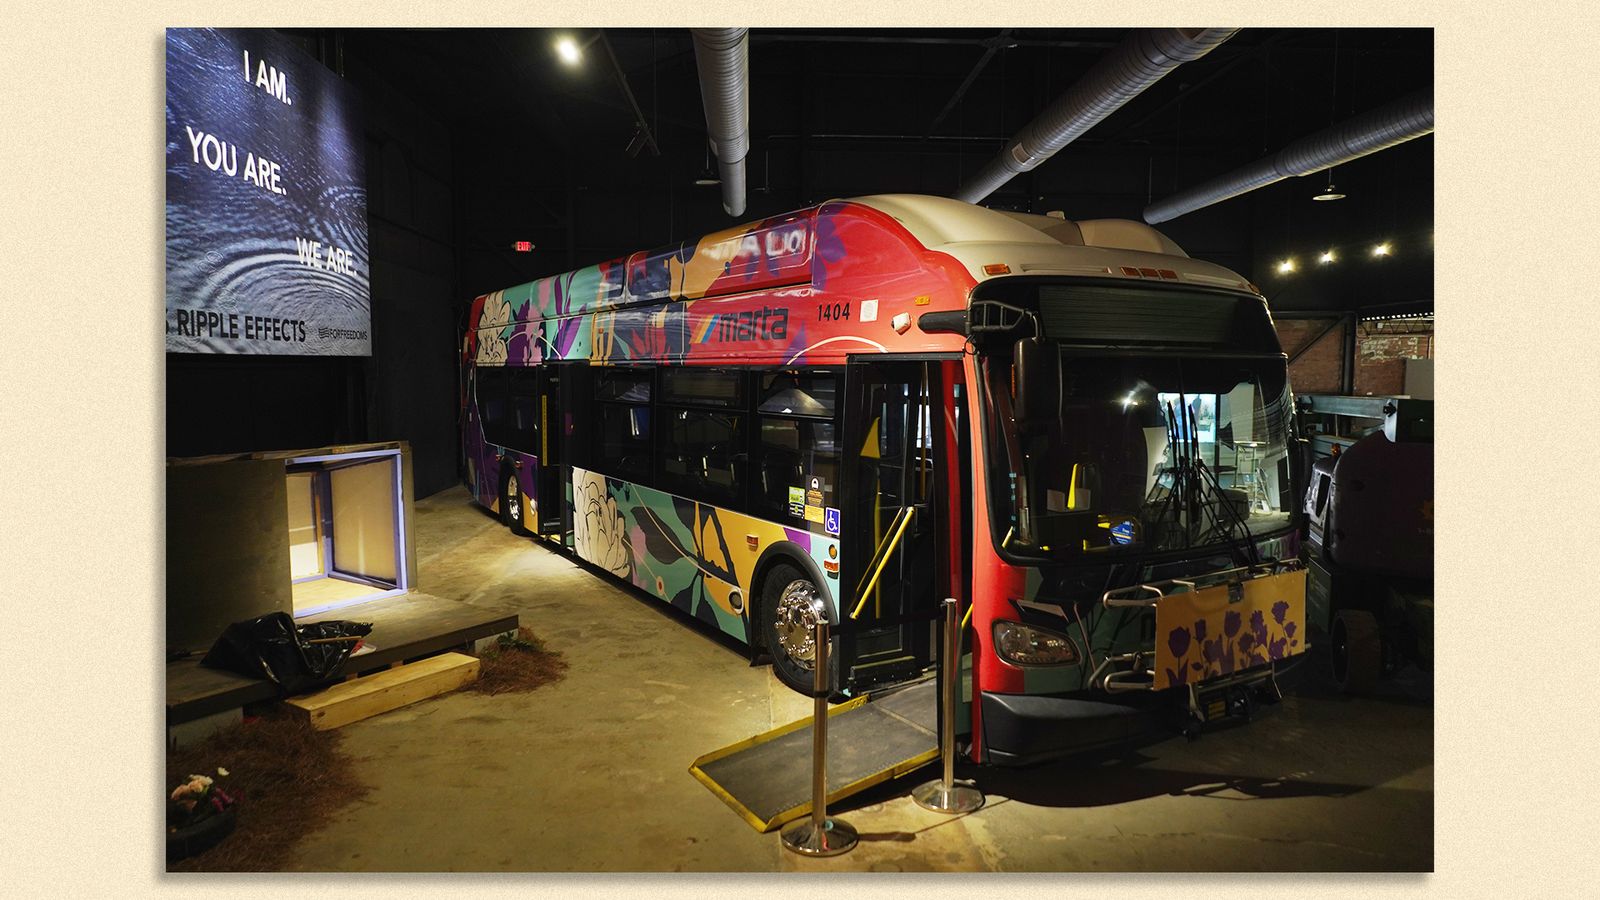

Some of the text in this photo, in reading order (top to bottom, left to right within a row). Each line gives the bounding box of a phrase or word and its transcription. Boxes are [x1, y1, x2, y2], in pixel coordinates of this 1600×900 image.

[243, 49, 292, 105] I AM.
[186, 125, 287, 195] YOU ARE.
[296, 237, 357, 276] WE ARE.
[177, 309, 239, 338] RIPPLE
[245, 315, 306, 342] EFFECTS
[719, 306, 789, 342] marta
[817, 303, 851, 321] 1404
